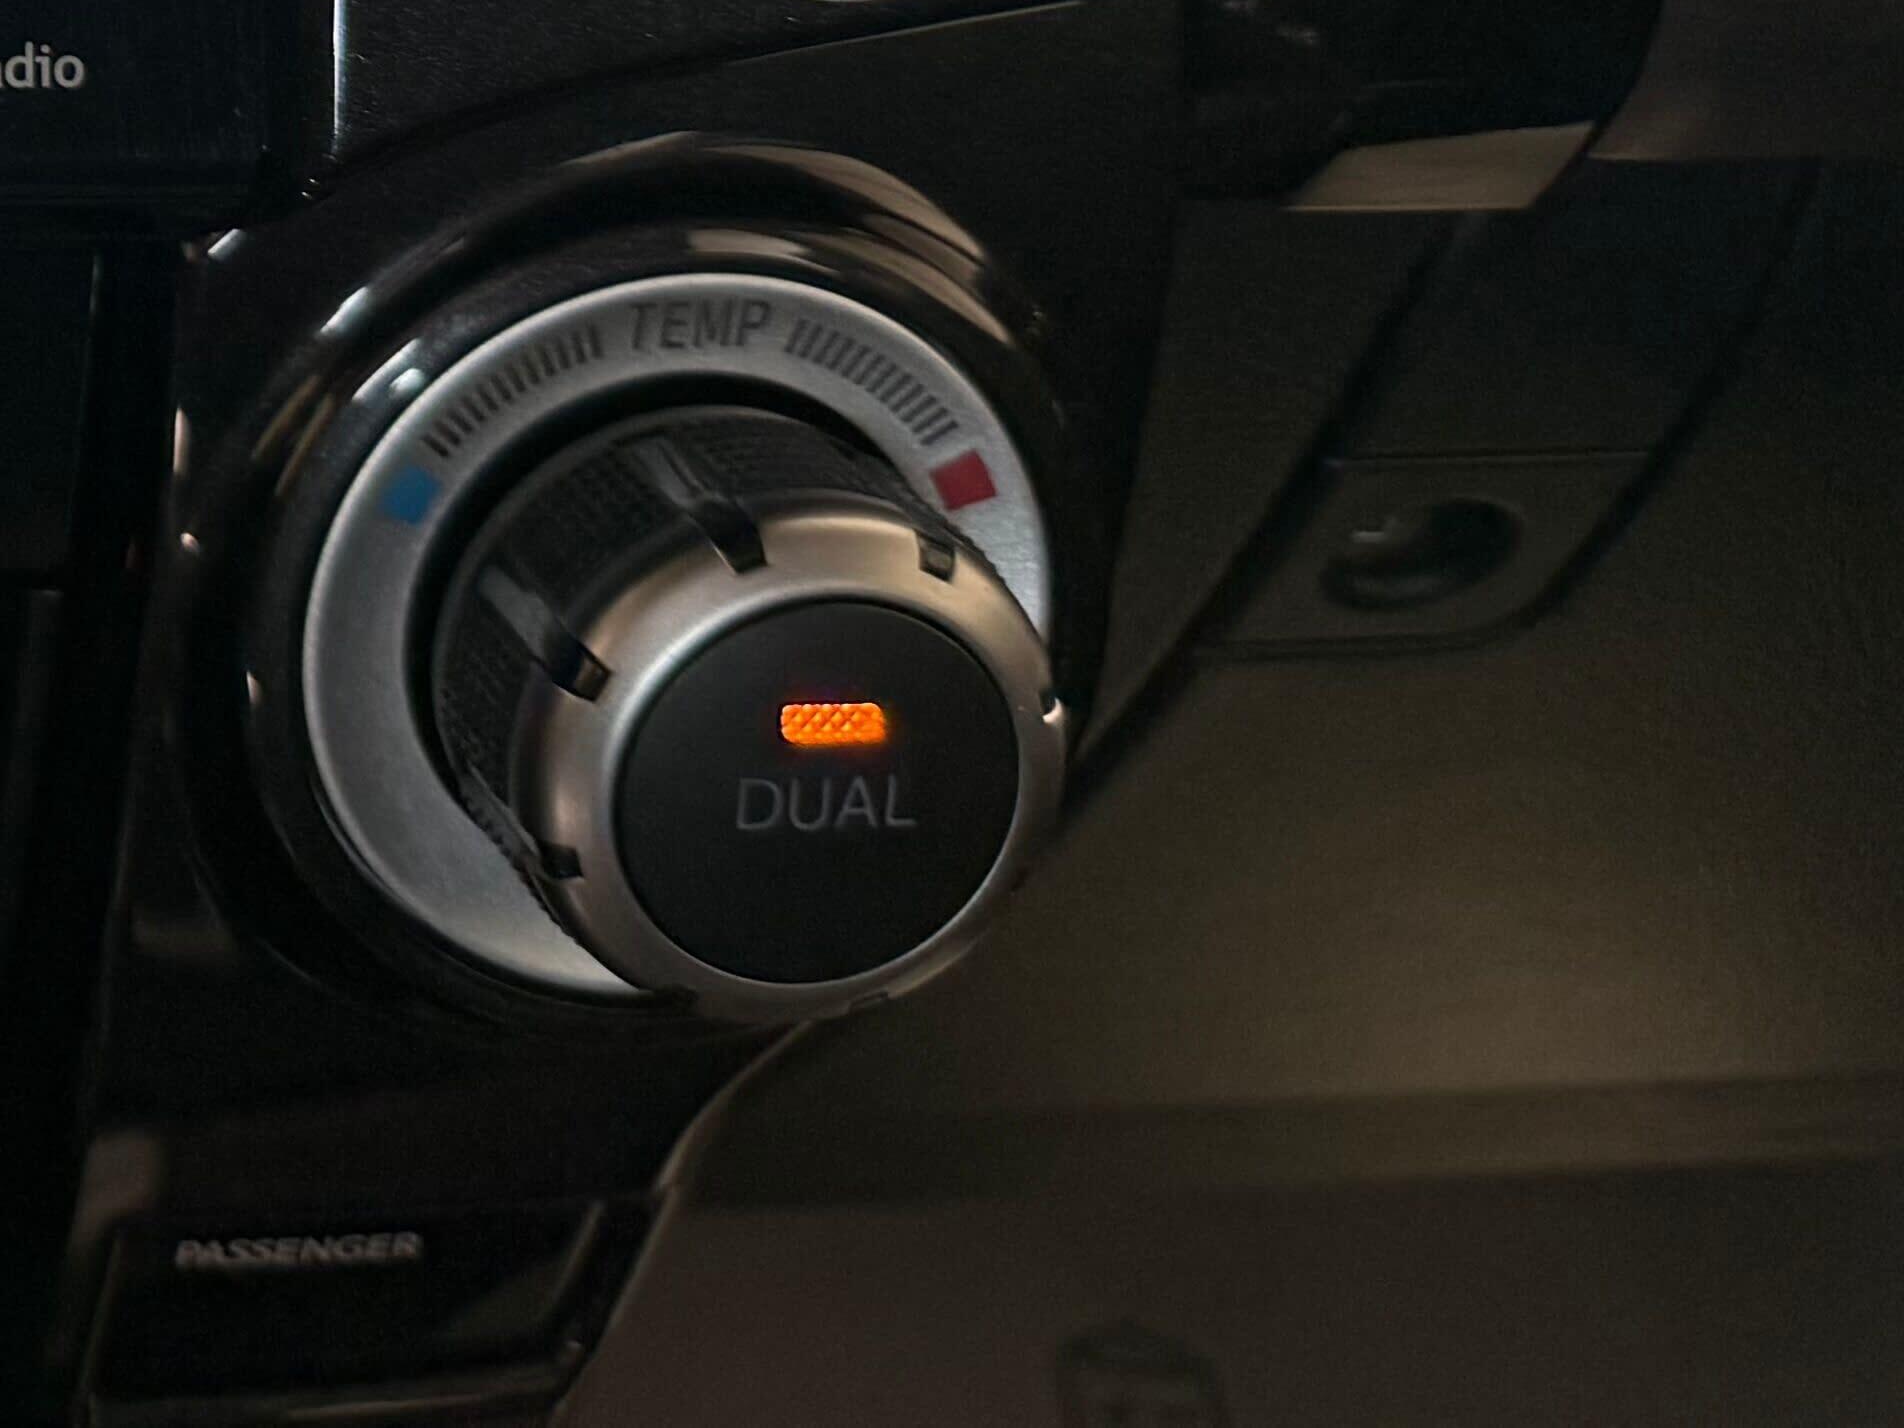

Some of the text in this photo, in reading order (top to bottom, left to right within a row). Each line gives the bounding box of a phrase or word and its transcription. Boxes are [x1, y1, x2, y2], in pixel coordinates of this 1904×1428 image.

[629, 299, 772, 350] TEMP
[735, 778, 917, 830] DUAL
[176, 1231, 423, 1268] PASSENGER
